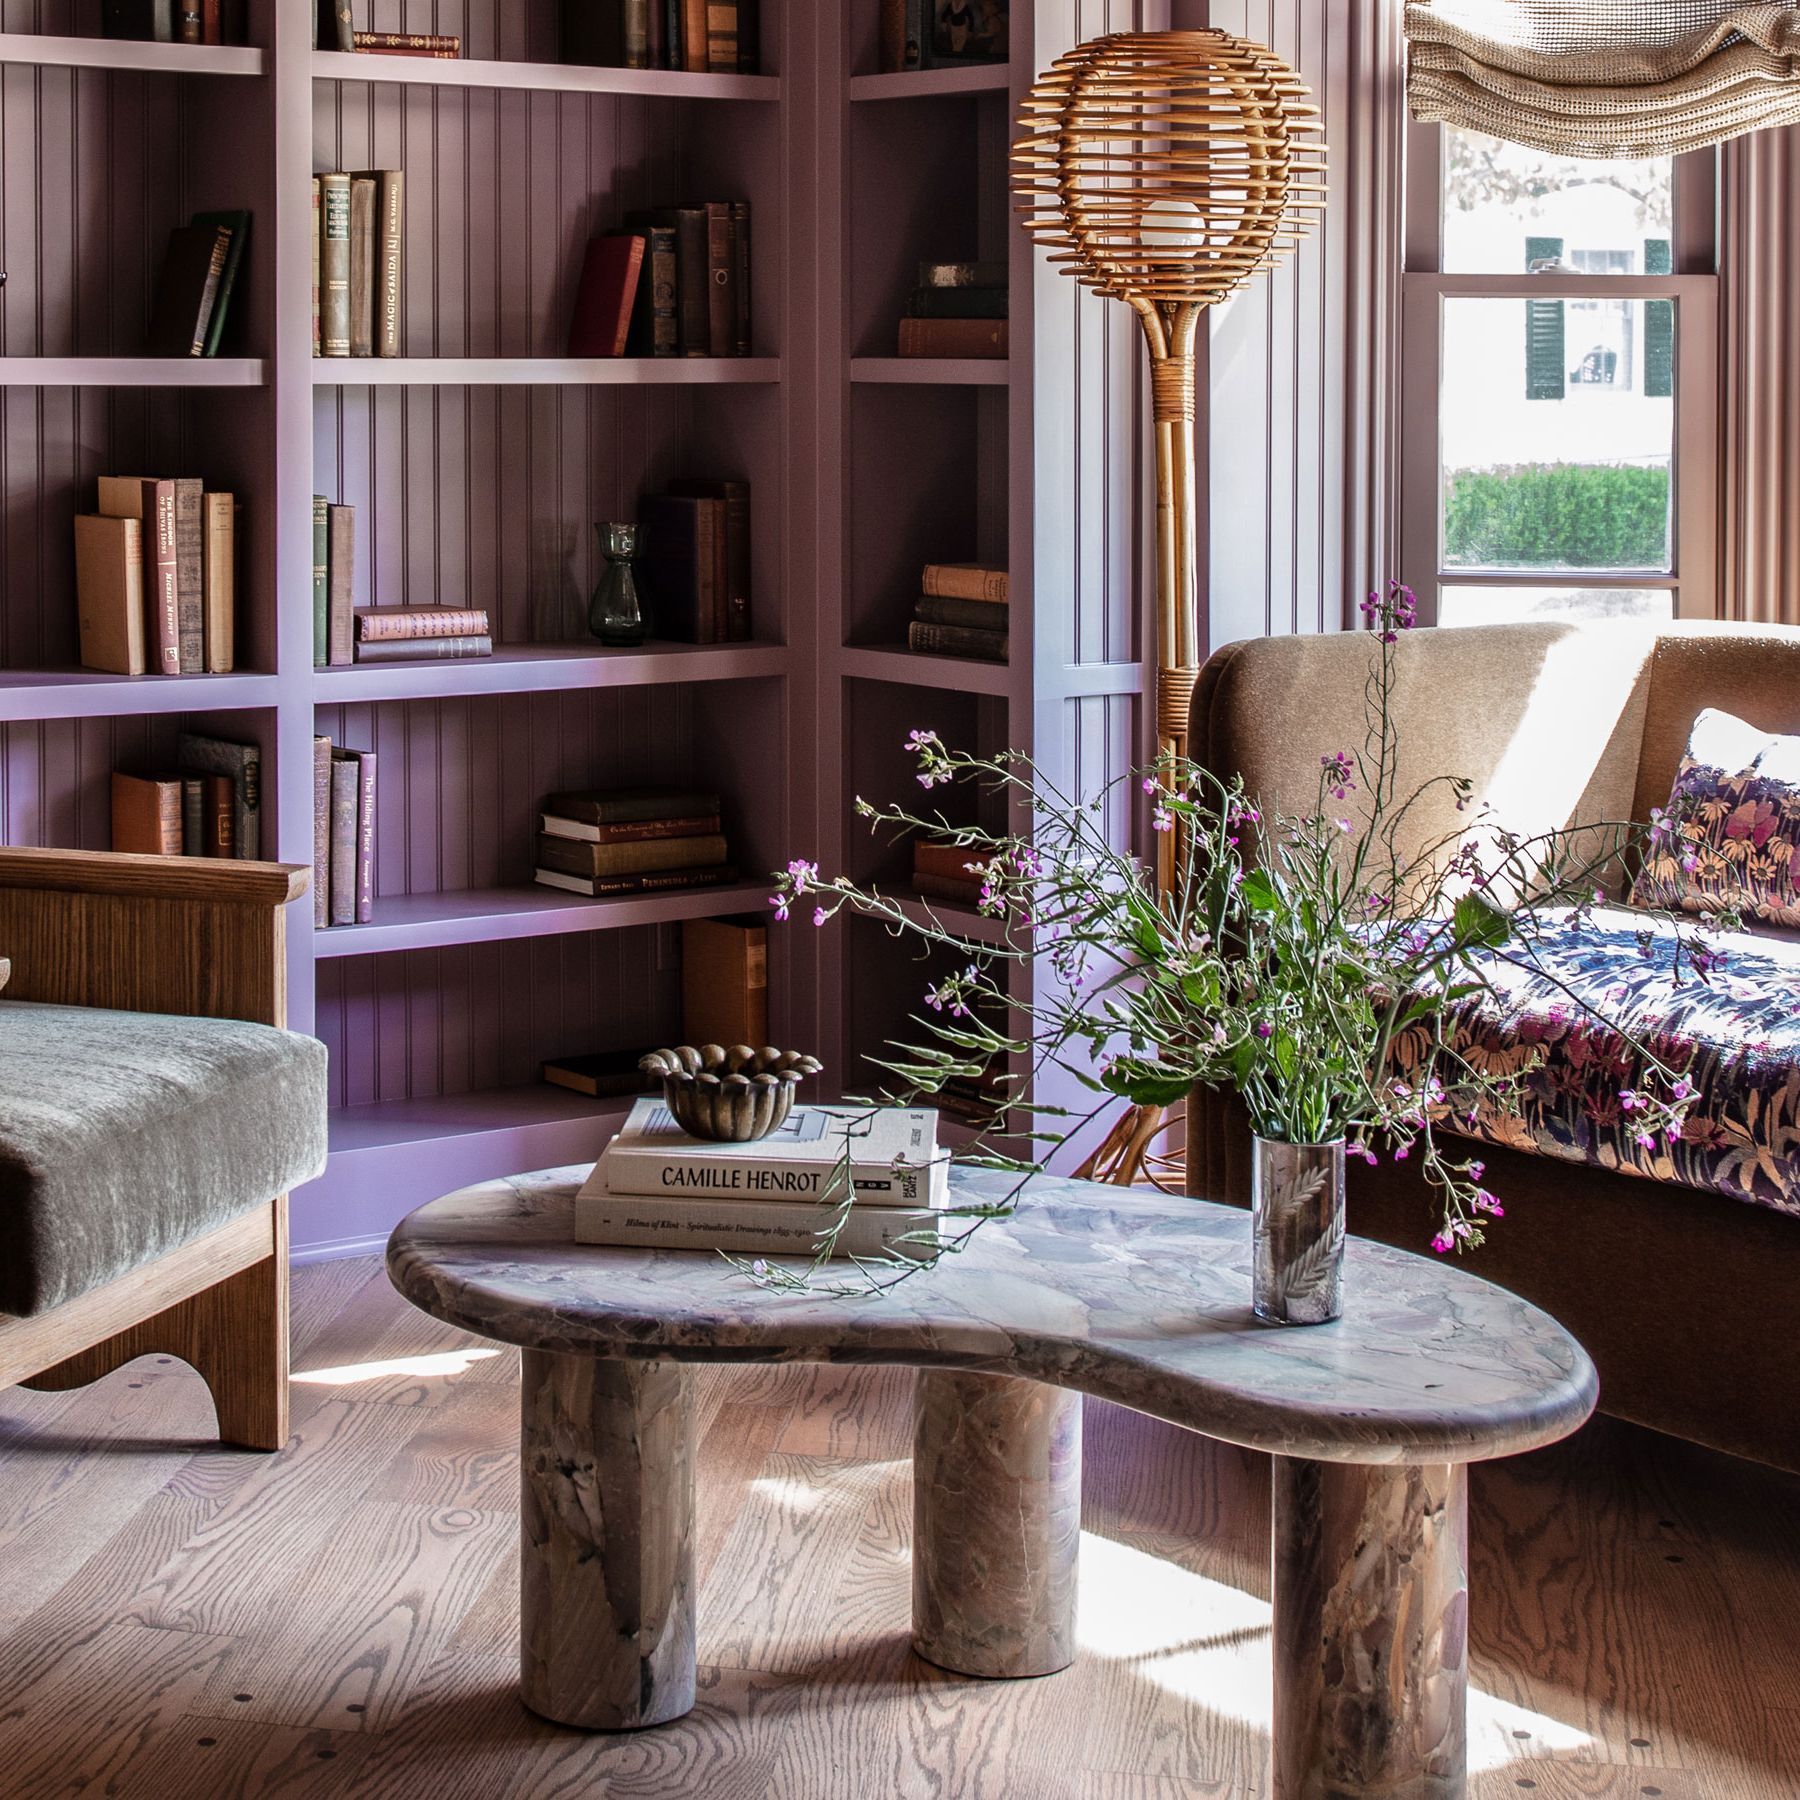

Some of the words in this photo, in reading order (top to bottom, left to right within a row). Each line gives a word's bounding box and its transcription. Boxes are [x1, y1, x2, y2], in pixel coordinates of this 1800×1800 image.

[390, 184, 398, 217] VASSANJI
[387, 255, 397, 287] SAIDA
[387, 294, 396, 330] MAGIC
[167, 515, 175, 546] KINGDOM
[365, 775, 374, 793] The
[362, 795, 373, 826] Hiding
[364, 828, 372, 852] Place
[662, 1166, 741, 1189] CAMILLE
[747, 1170, 822, 1192] HENROT
[625, 1218, 650, 1228] Hilma
[660, 1220, 679, 1229] Klint
[687, 1222, 734, 1232] Spiritualistic
[735, 1223, 771, 1236] Drawings
